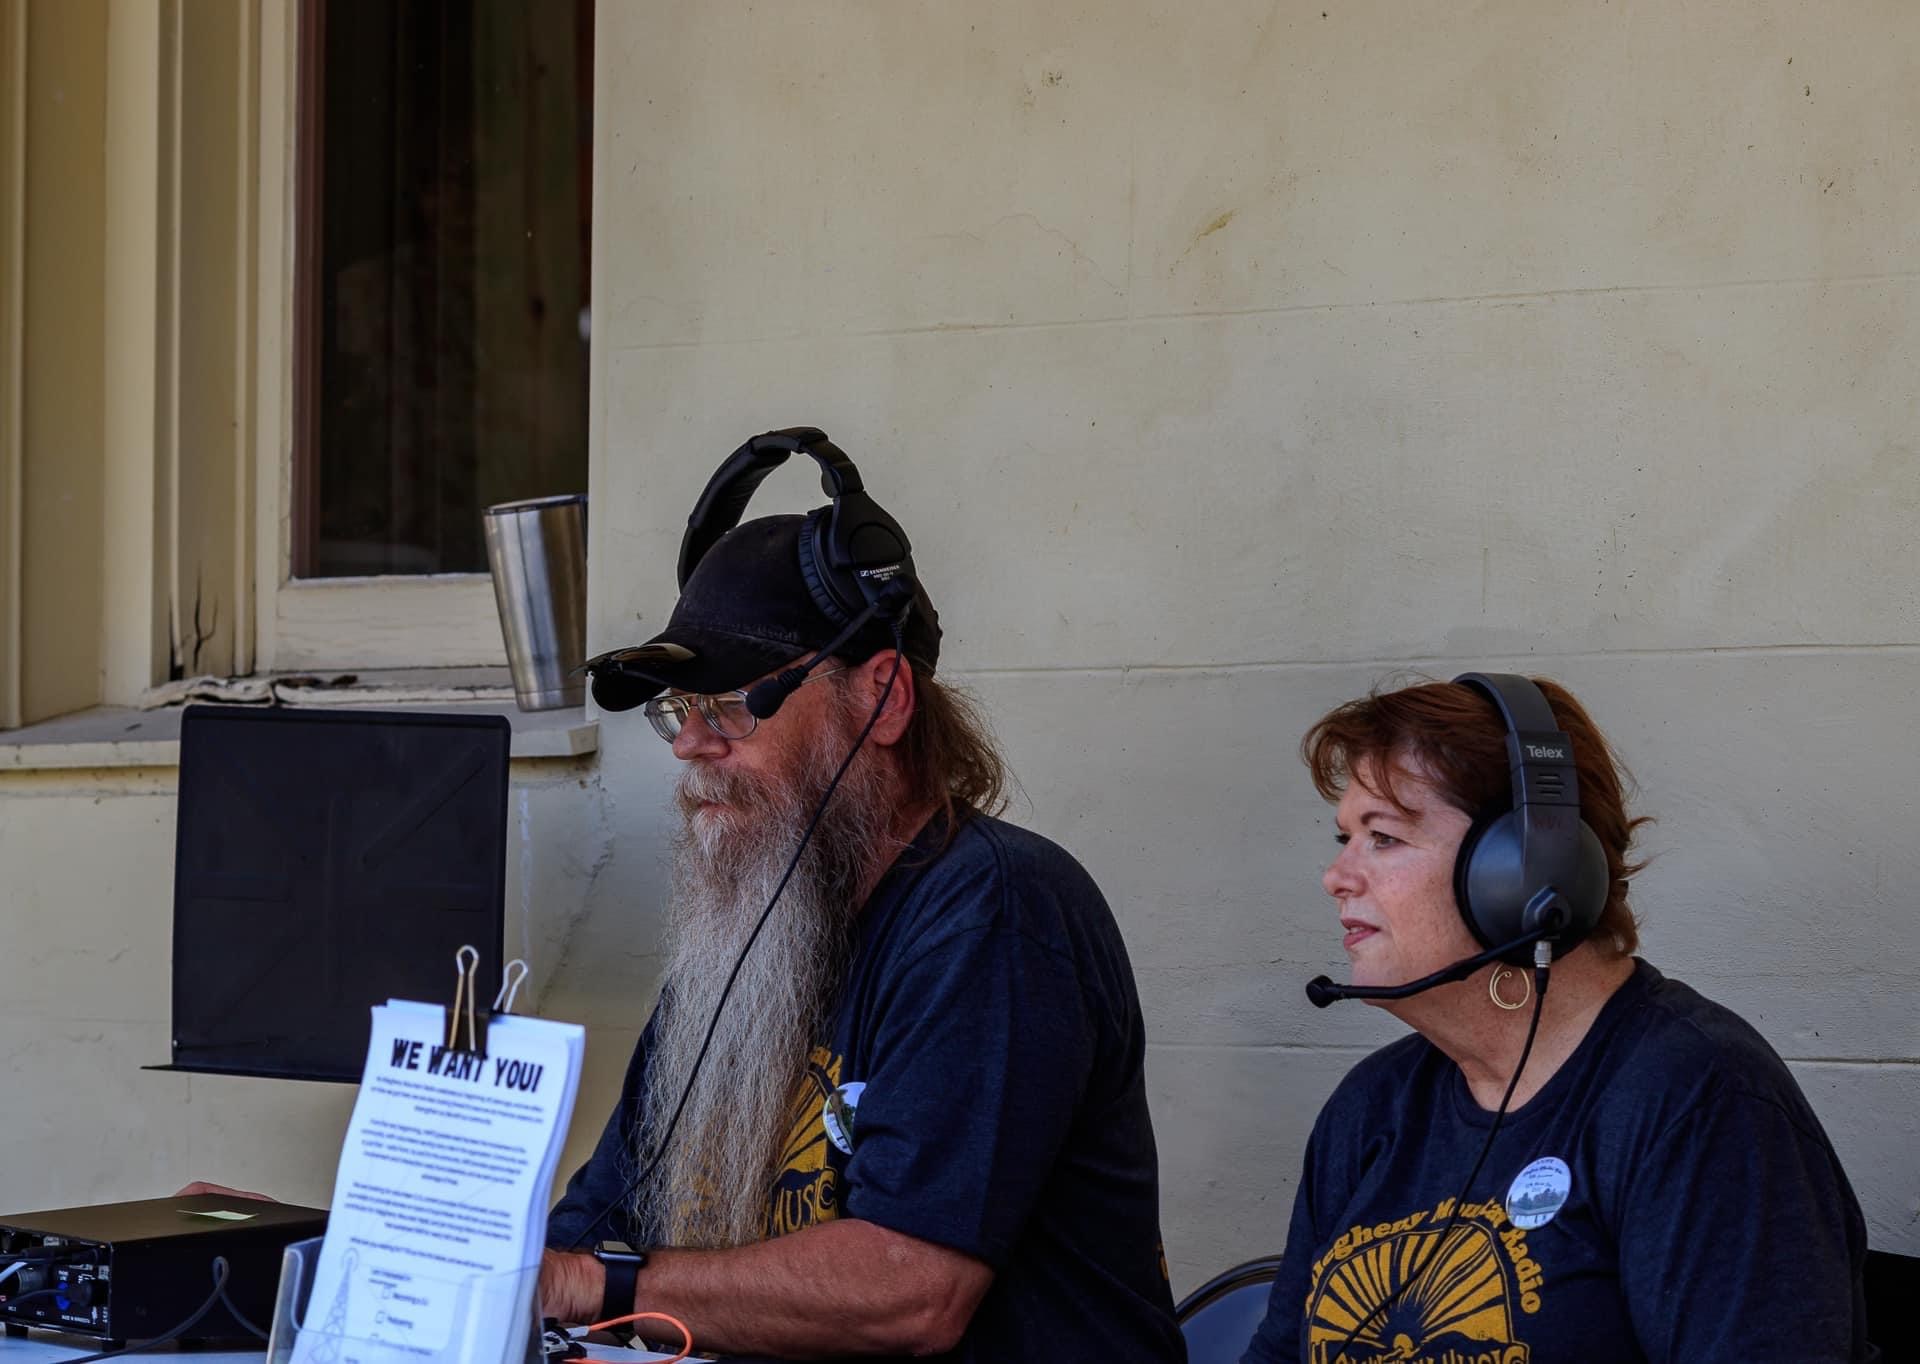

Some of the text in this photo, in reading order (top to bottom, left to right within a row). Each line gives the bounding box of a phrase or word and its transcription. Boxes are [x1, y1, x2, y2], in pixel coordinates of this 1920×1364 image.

[1526, 745, 1564, 759] Telex
[390, 1038, 544, 1093] WE WANT YOU!
